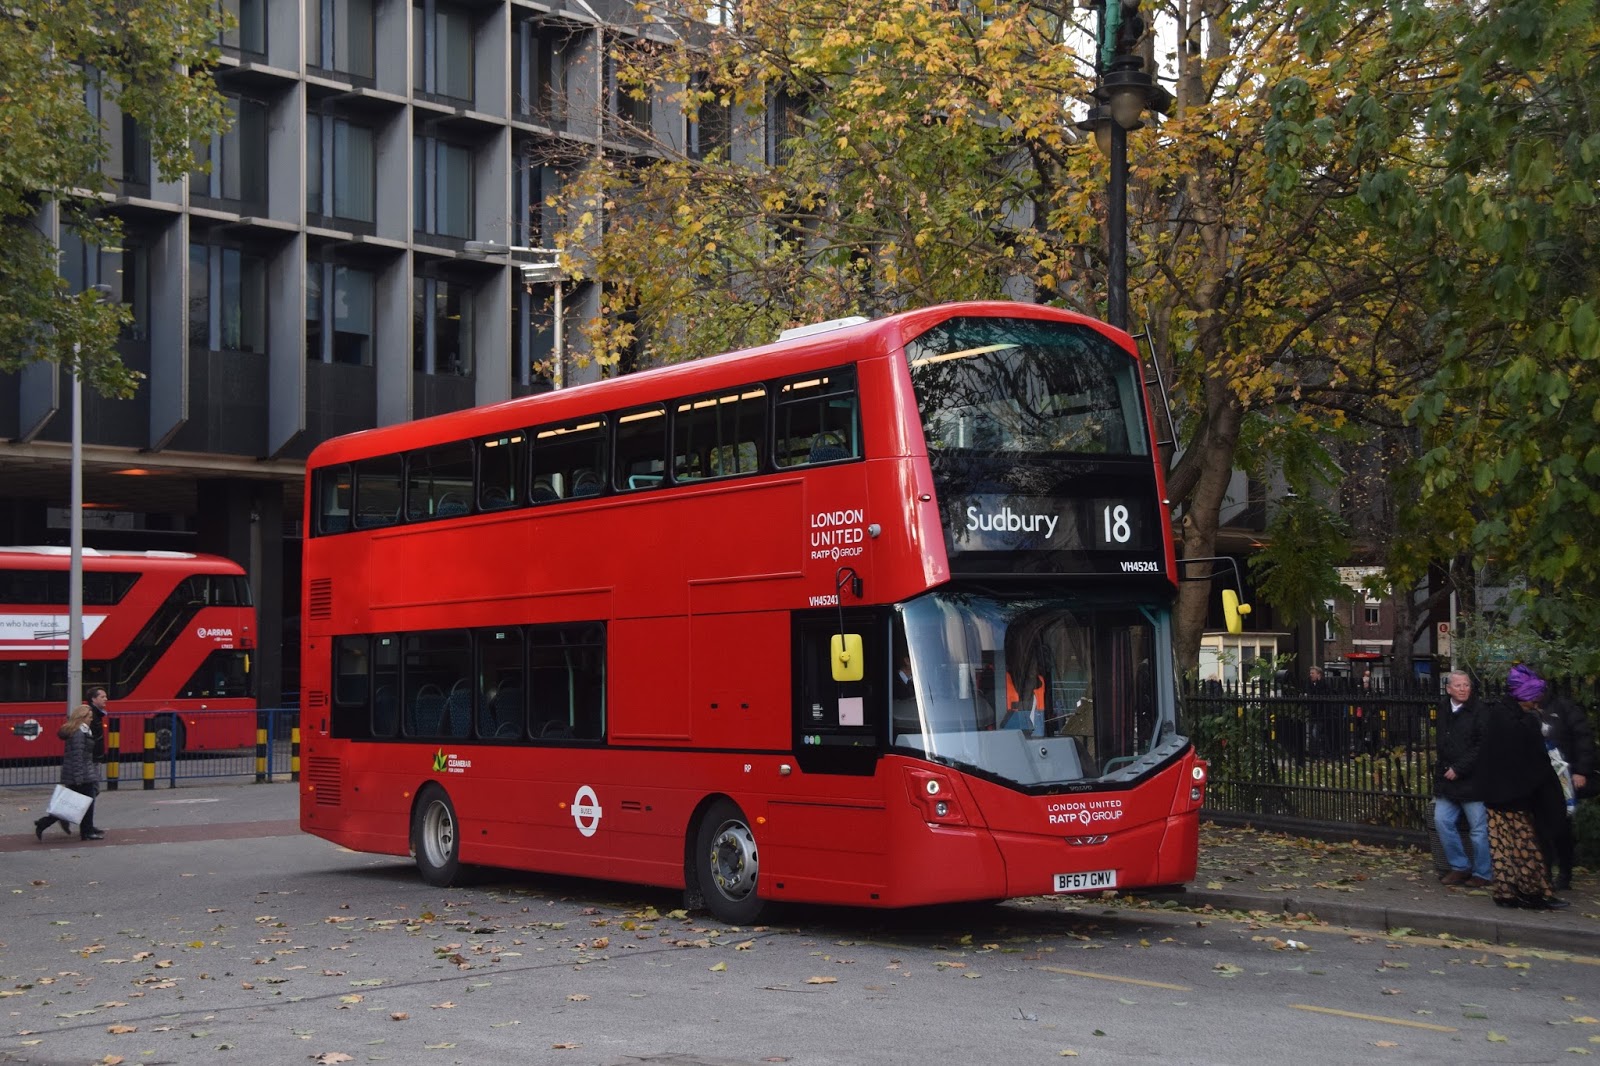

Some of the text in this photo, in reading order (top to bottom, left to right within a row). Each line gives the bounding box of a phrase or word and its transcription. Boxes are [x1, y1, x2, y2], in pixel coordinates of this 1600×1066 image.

[811, 509, 863, 528] LONDON
[966, 505, 1059, 539] Sudbury
[1103, 504, 1131, 543] 18
[811, 528, 863, 547] UNITED
[811, 547, 863, 560] RATP GROUP
[1120, 561, 1159, 572] VH45241
[809, 595, 838, 607] VH45241
[206, 628, 233, 636] ARRIVA
[744, 764, 752, 772] RP
[580, 807, 592, 815] BUSES
[1048, 800, 1122, 812] LONDON UNITED
[1049, 810, 1123, 824] RATP GROUP
[1059, 871, 1112, 889] BF67 GMV
